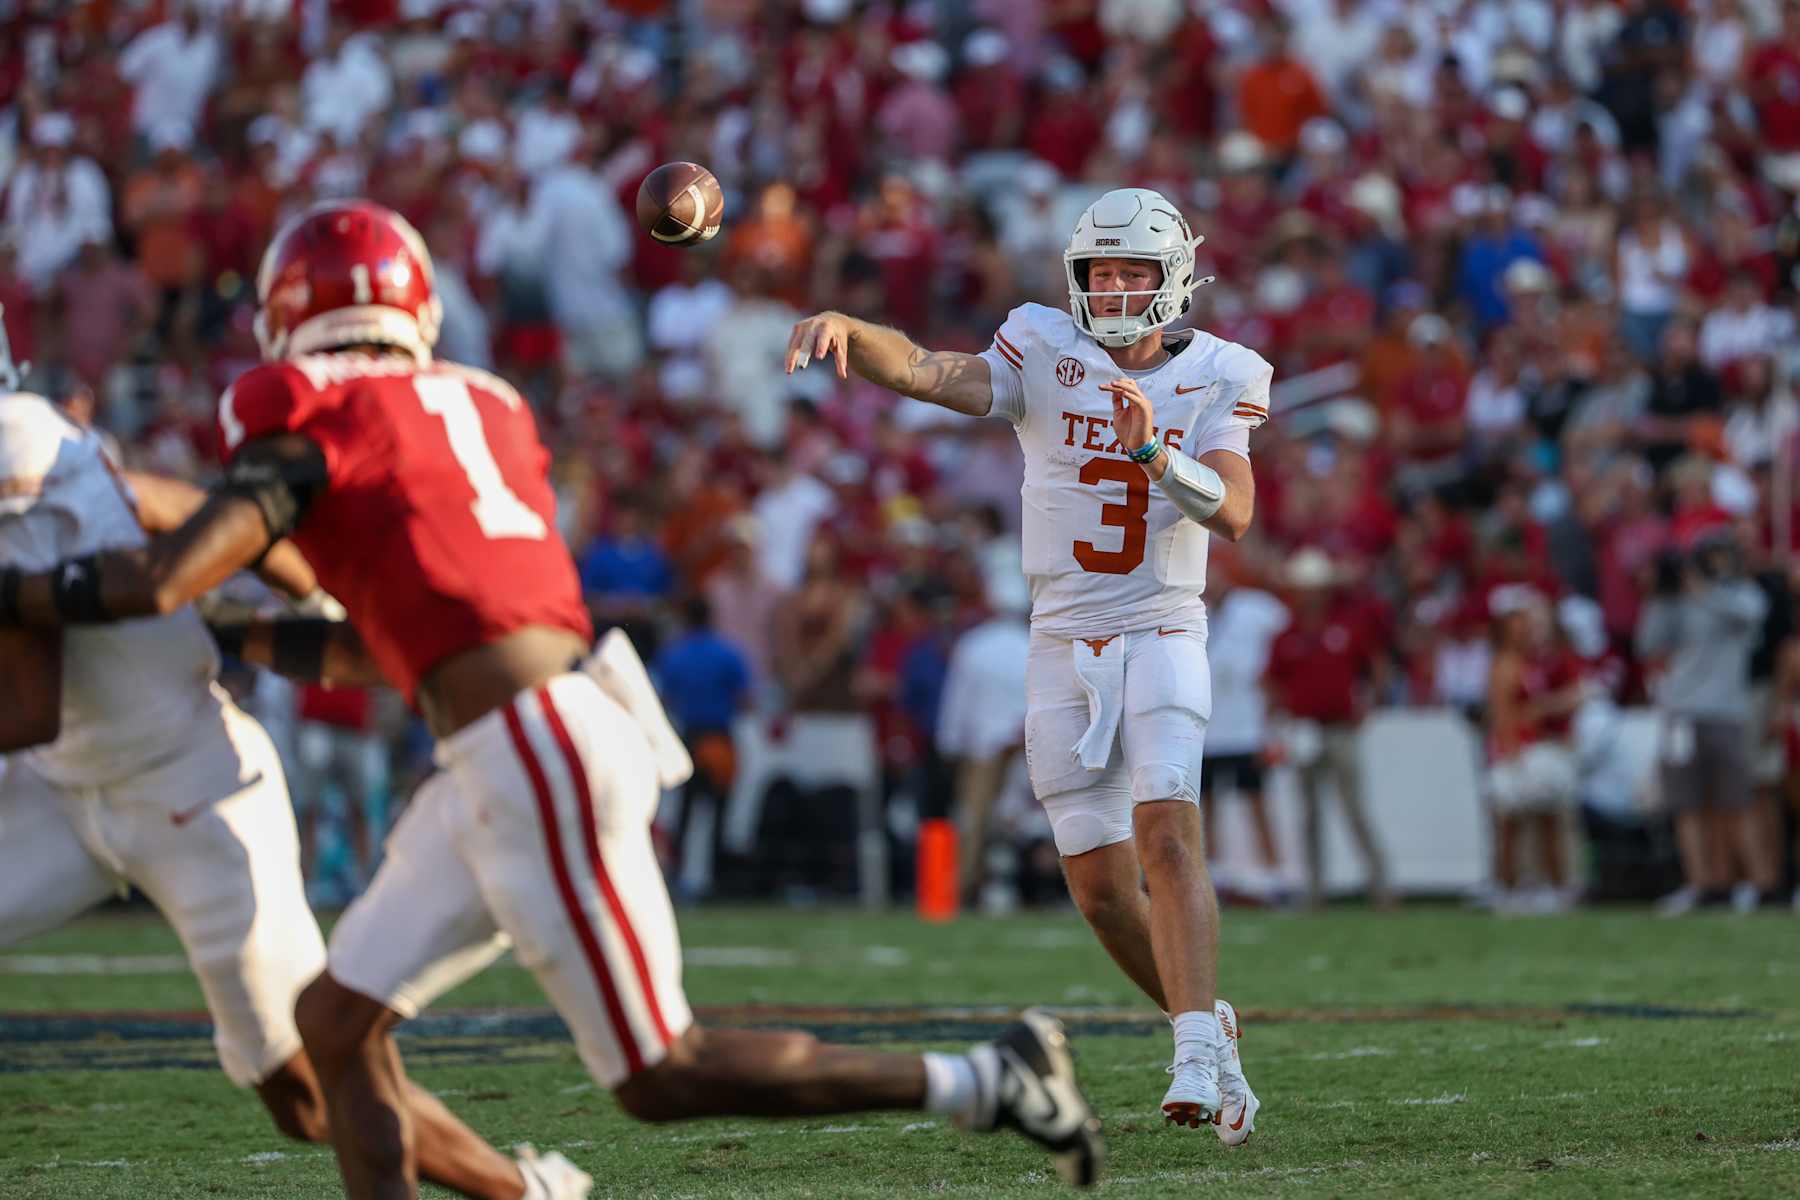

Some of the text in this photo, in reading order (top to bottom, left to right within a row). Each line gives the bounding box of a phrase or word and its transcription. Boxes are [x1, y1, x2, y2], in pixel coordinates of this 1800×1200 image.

[1095, 238, 1121, 247] HORNS
[351, 262, 373, 304] 1
[1056, 358, 1085, 386] SEC
[1061, 411, 1185, 456] TEXS
[413, 375, 547, 540] 1
[1073, 456, 1150, 575] 3
